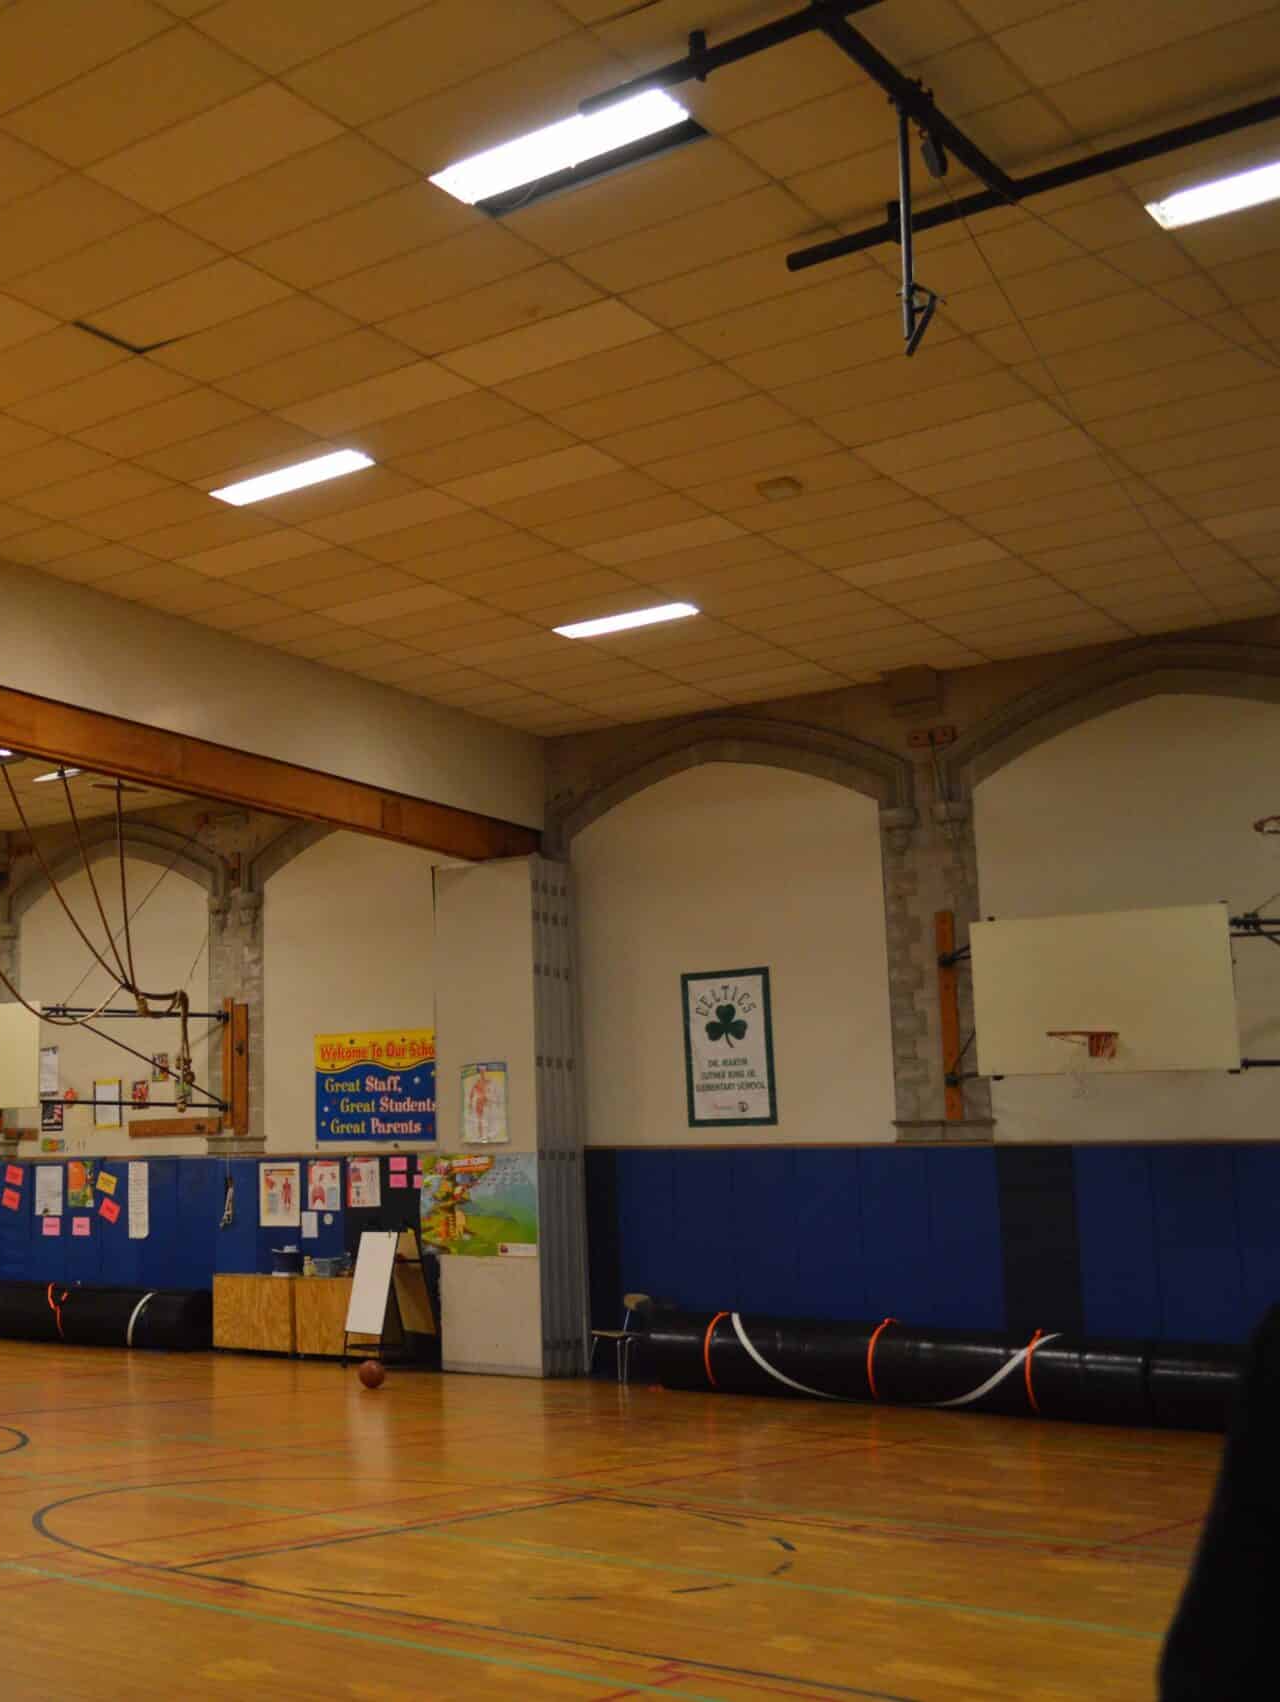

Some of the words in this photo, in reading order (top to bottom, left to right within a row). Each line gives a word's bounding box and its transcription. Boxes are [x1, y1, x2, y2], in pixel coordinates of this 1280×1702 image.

[696, 984, 757, 1017] CELTICS
[320, 1044, 368, 1059] Welcome
[372, 1043, 383, 1058] To
[387, 1042, 406, 1057] Our
[325, 1077, 360, 1093] Great
[365, 1075, 403, 1093] Staff,
[340, 1097, 375, 1113] Great
[330, 1118, 366, 1134] Great
[370, 1117, 422, 1134] Parents
